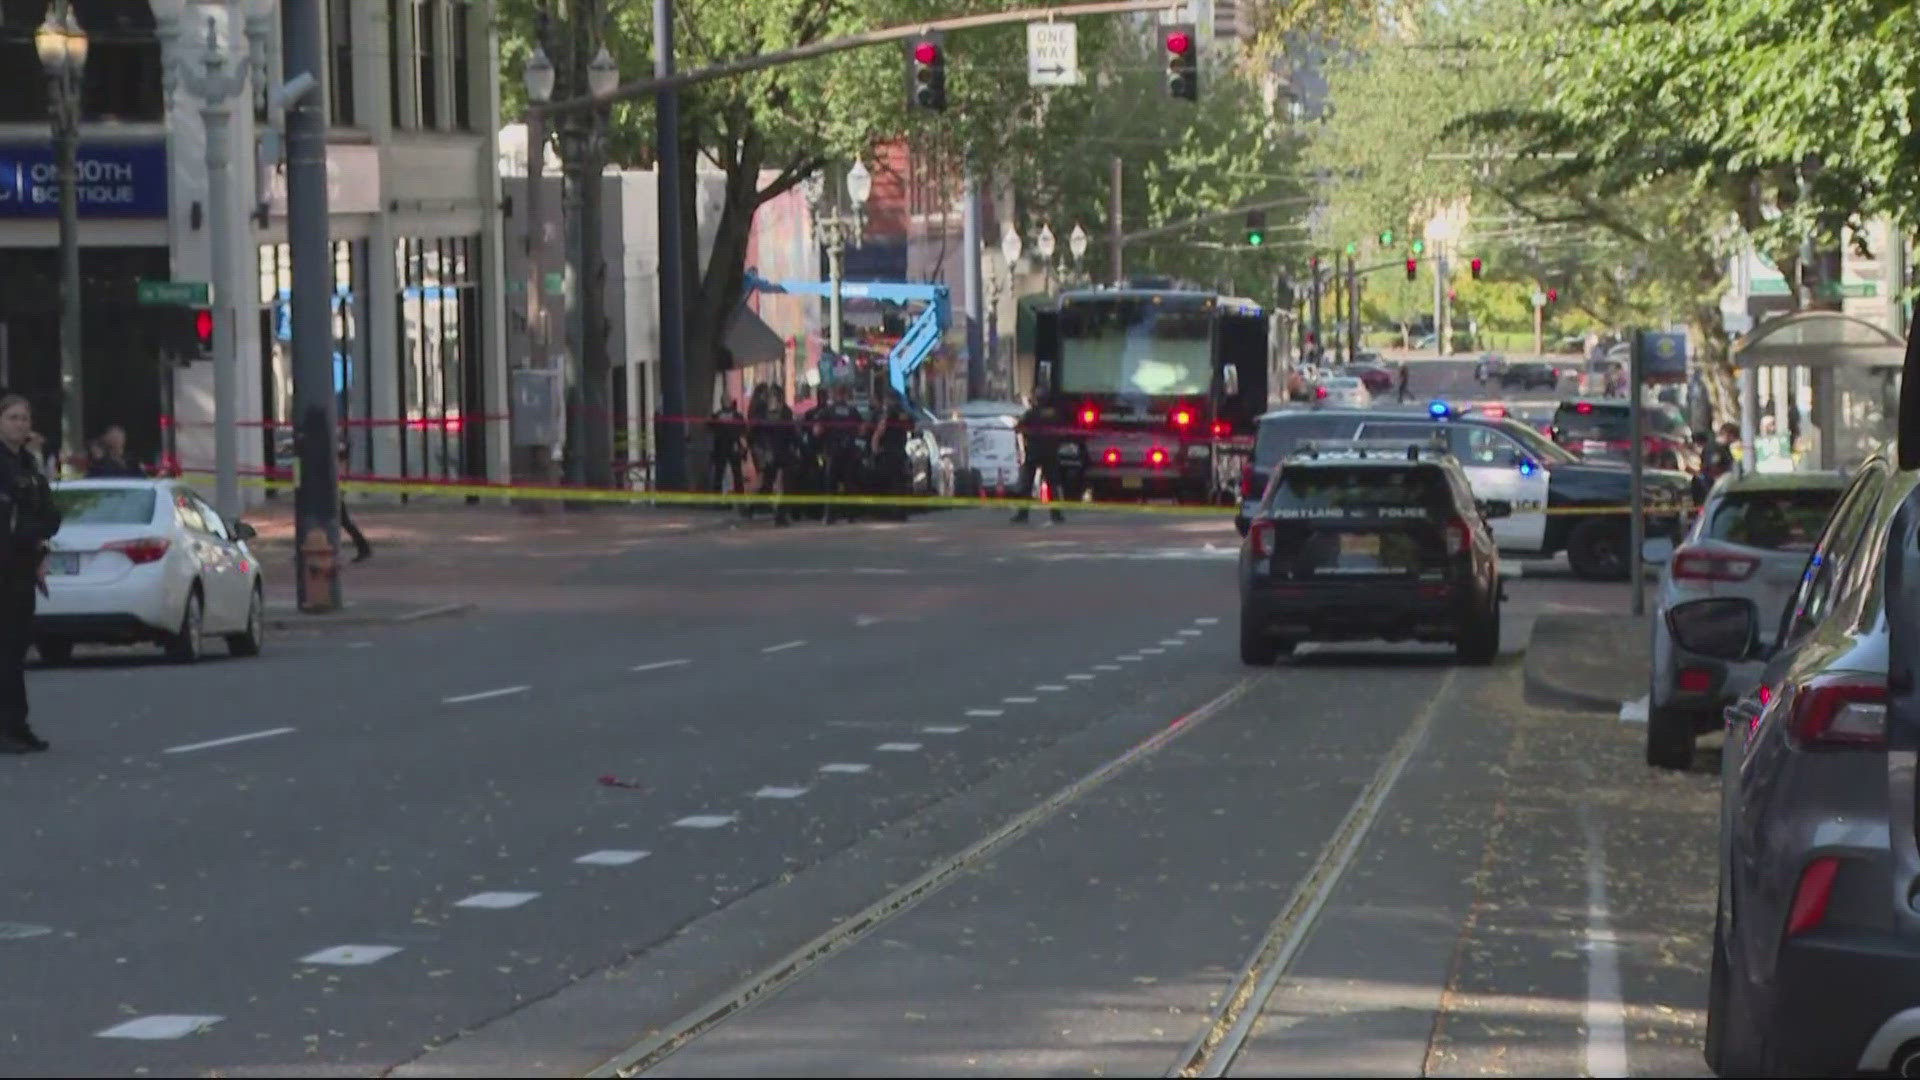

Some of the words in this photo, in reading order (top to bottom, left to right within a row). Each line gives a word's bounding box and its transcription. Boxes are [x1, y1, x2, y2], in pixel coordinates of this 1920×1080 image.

[1036, 29, 1068, 42] ONE
[1036, 45, 1069, 59] WAY
[1273, 507, 1344, 519] PORTLAND
[1378, 507, 1427, 518] POLICE
